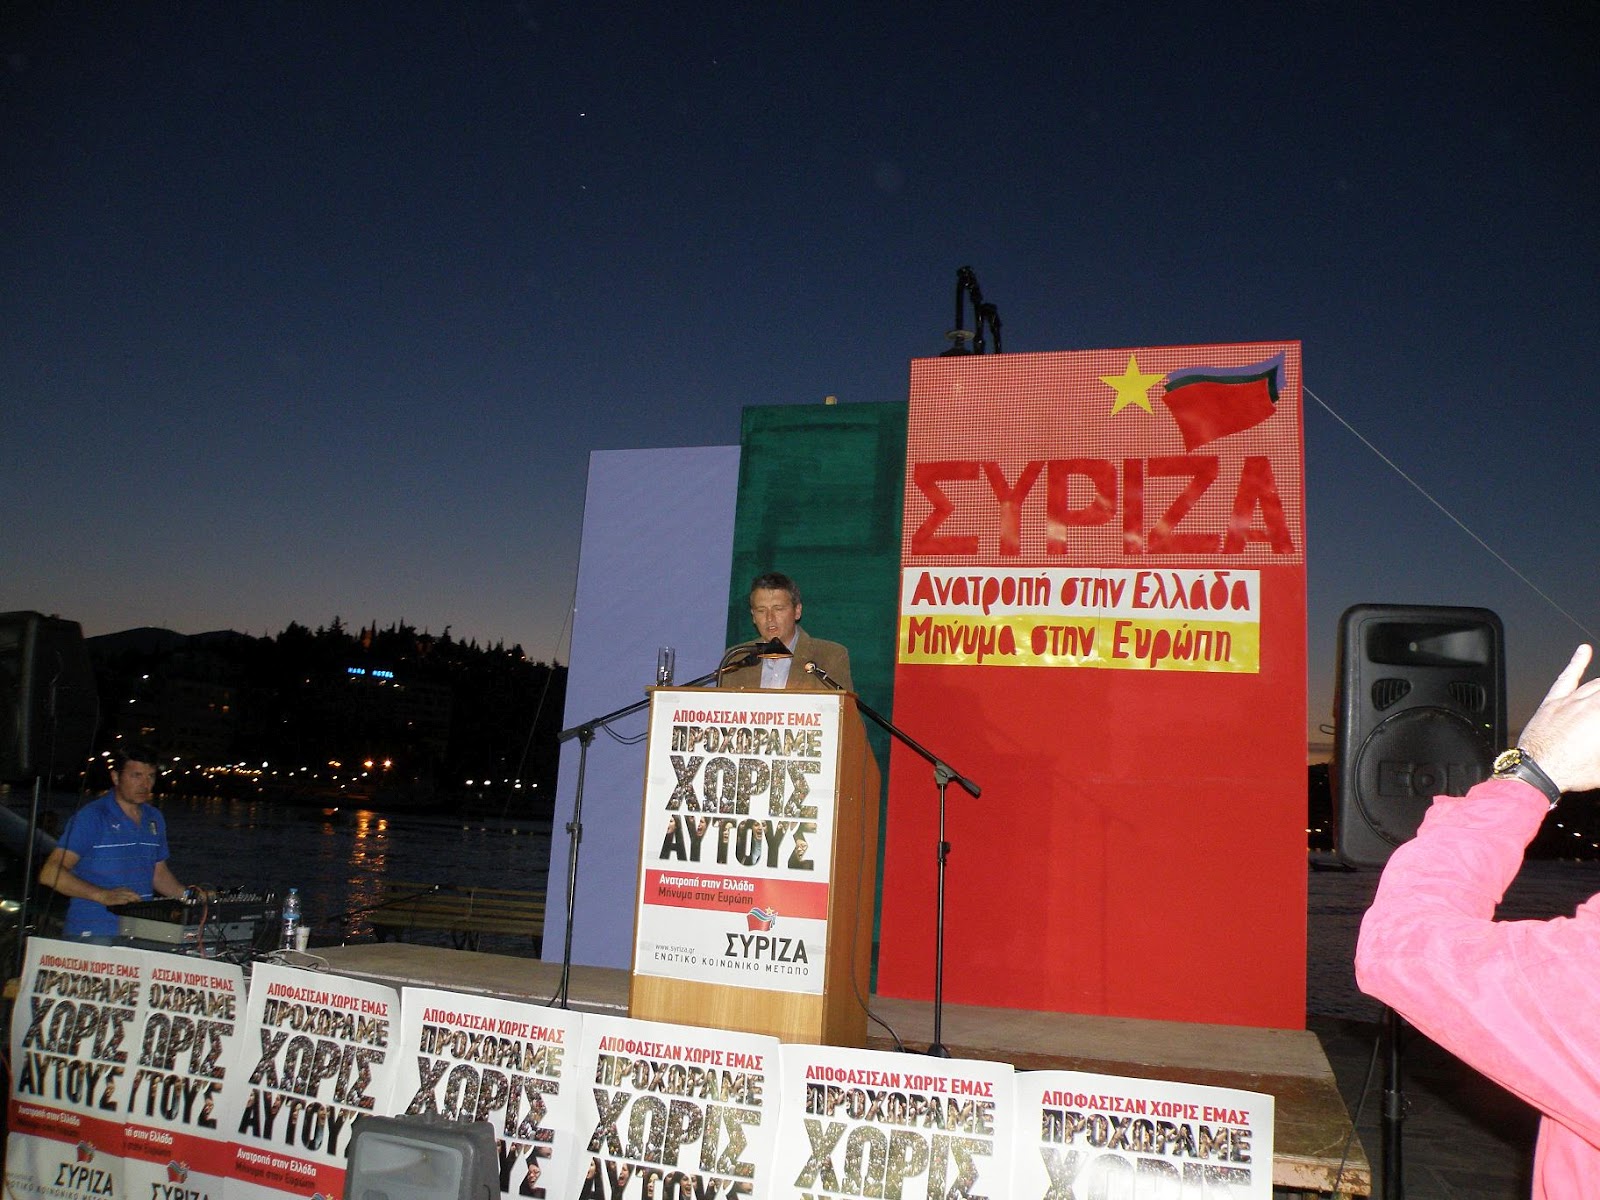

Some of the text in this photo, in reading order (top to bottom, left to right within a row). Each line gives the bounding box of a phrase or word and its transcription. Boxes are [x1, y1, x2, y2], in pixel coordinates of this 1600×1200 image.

[911, 455, 1295, 555] ΣΥΡΙΖΑ
[911, 571, 1250, 615] Ανατροπή στην Ελλάδα
[1031, 624, 1095, 657] στην
[1112, 620, 1231, 667] Ευρώπη
[673, 709, 821, 726] ΑΠΟΦΑΣΙΣΑΝ ΧΩΡΙΣ ΕΜΑΣ
[671, 725, 823, 758] ΠΡΟΧΩΡΑΜΕ
[665, 755, 821, 819] ΧΩΡΙΣ
[659, 814, 817, 871] ΑΥΤΟΥΣ
[658, 887, 753, 906] Μήνυμα στην Ευρώπη
[659, 873, 754, 891] Ανατροπή στην Ελλάδα
[40, 954, 140, 978] ΑΠΟΦΑΣΙΣΑΝ ΧΩΡΙΣ ΕΜΑΣ
[655, 944, 695, 954] www.syriza.gr
[655, 952, 809, 976] ΕΝΩΤΙΚΟ ΚΟΙΝΩΝΙΚΟ ΜΕΤΩΠΟ
[725, 933, 808, 964] ΣΥΡΙΖΑ
[34, 969, 140, 1008] ΠΡΟΧΩΡΑΜΕ
[184, 974, 208, 988] ΧΩΡΙΣ
[210, 978, 234, 991] ΕΜΑΣ
[267, 983, 388, 1017] ΑΠΟΦΑΣΙΣΑΝ ΧΩΡΙΣ ΕΜΑΣ
[22, 996, 135, 1064] ΧΩΡΙΣ
[263, 998, 389, 1048] ΠΡΟΧΩΡΑΜΕ
[423, 1007, 565, 1043] ΑΠΟΦΑΣΙΣΑΝ ΧΩΡΙΣ ΕΜΑΣ
[138, 1012, 235, 1079] ΩΡΙΣ
[419, 1025, 565, 1077] ΠΡΟΧΩΡΑΜΕ
[599, 1035, 763, 1071] ΑΠΟΦΑΣΙΣΑΝ ΧΩΡΙΣ ΕΜΑΣ
[18, 1052, 124, 1112] ΑΥΤΟΥΣ
[249, 1028, 386, 1110] ΧΩΡΙΣ
[595, 1054, 765, 1107] ΠΡΟΧΩΡΑΜΕ
[805, 1064, 993, 1097] ΑΠΟΦΑΣΙΣΑΝ ΧΩΡΙΣ ΕΜΑΣ
[405, 1056, 560, 1142] ΧΩΡΙΣ
[806, 1082, 995, 1136] ΠΡΟΧΩΡΑΜΕ
[1041, 1090, 1249, 1126] ΑΠΟΦΑΣΙΣΑΝ ΧΩΡΙΣ ΕΜΑΣ
[238, 1088, 375, 1158] ΑΥΤΟΥ
[587, 1088, 762, 1179] ΧΩΡΙΣ
[1041, 1108, 1253, 1164] ΠΡΟΧΩΡΑΜΕ
[55, 1162, 113, 1196] ΣΥΡΙΖΑ
[290, 1160, 317, 1176] Ελλάδα
[794, 1118, 993, 1200] ΧΩΡΙΣ
[152, 1183, 208, 1200] ΣΥΡ
